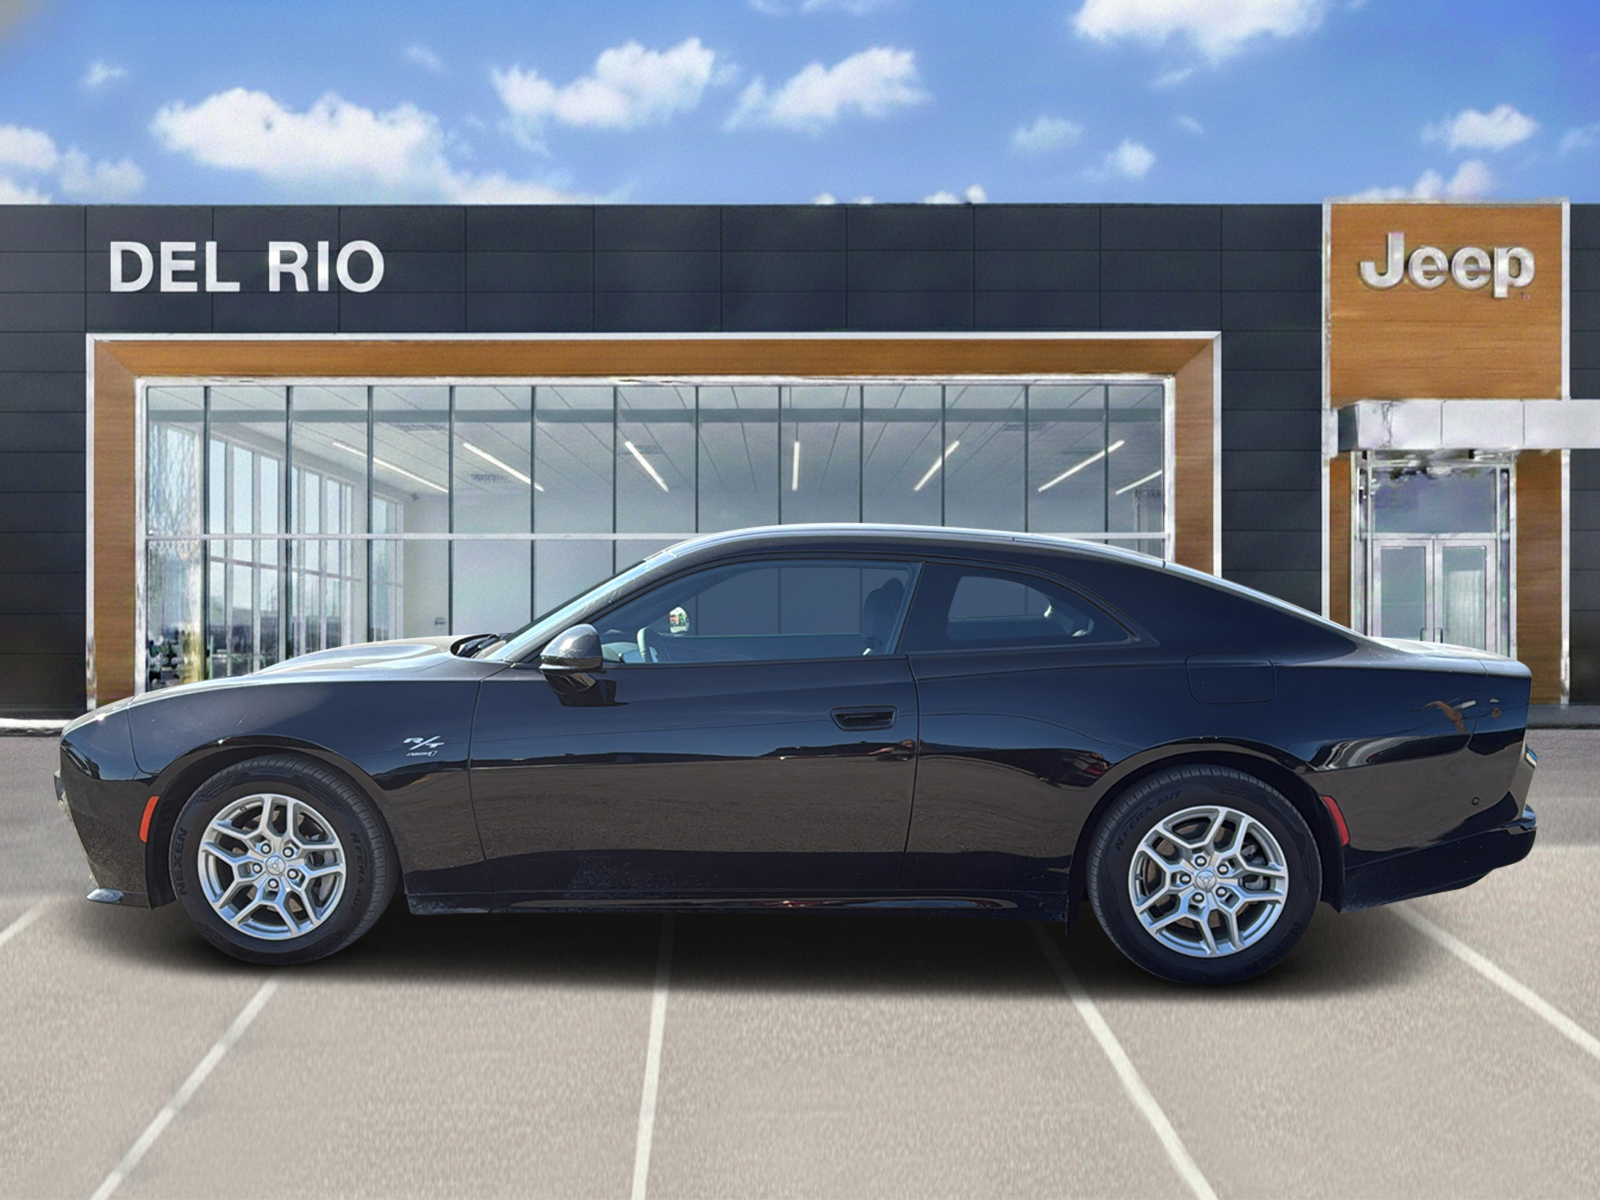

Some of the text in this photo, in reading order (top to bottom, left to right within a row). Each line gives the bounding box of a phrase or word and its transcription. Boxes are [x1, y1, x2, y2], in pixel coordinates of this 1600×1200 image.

[110, 240, 385, 292] DEL RIO
[1359, 232, 1535, 298] Jeep
[174, 827, 188, 896] NEXEN
